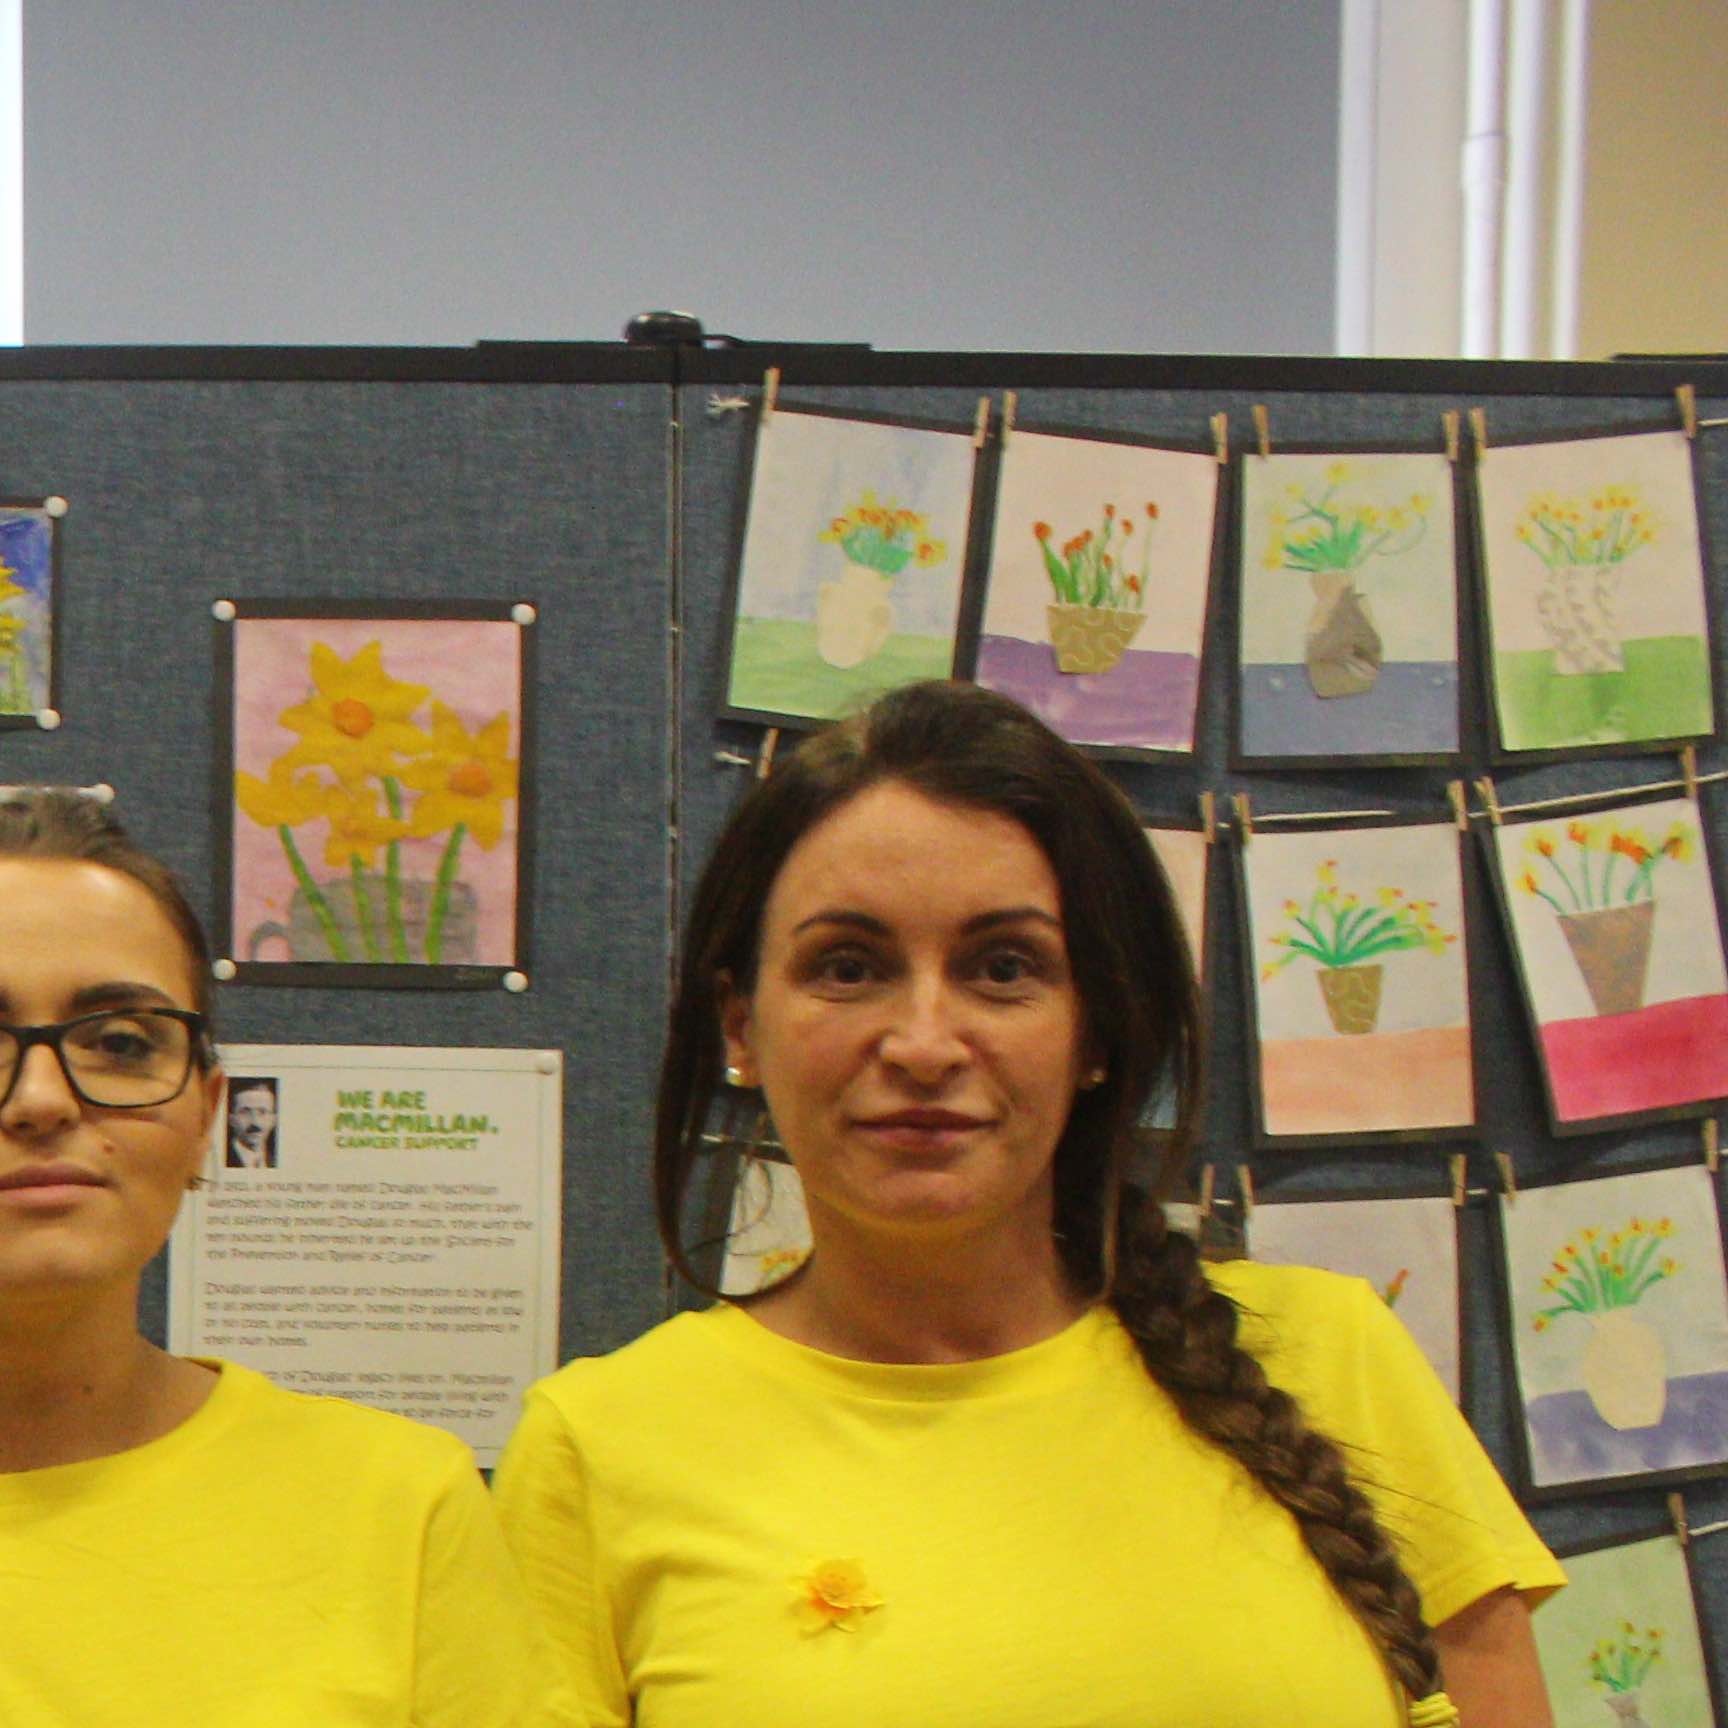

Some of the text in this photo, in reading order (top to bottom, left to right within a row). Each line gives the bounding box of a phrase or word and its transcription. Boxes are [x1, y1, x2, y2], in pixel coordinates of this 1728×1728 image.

[336, 1090, 426, 1110] WE ARE
[335, 1136, 479, 1150] CANCER SUPPORT
